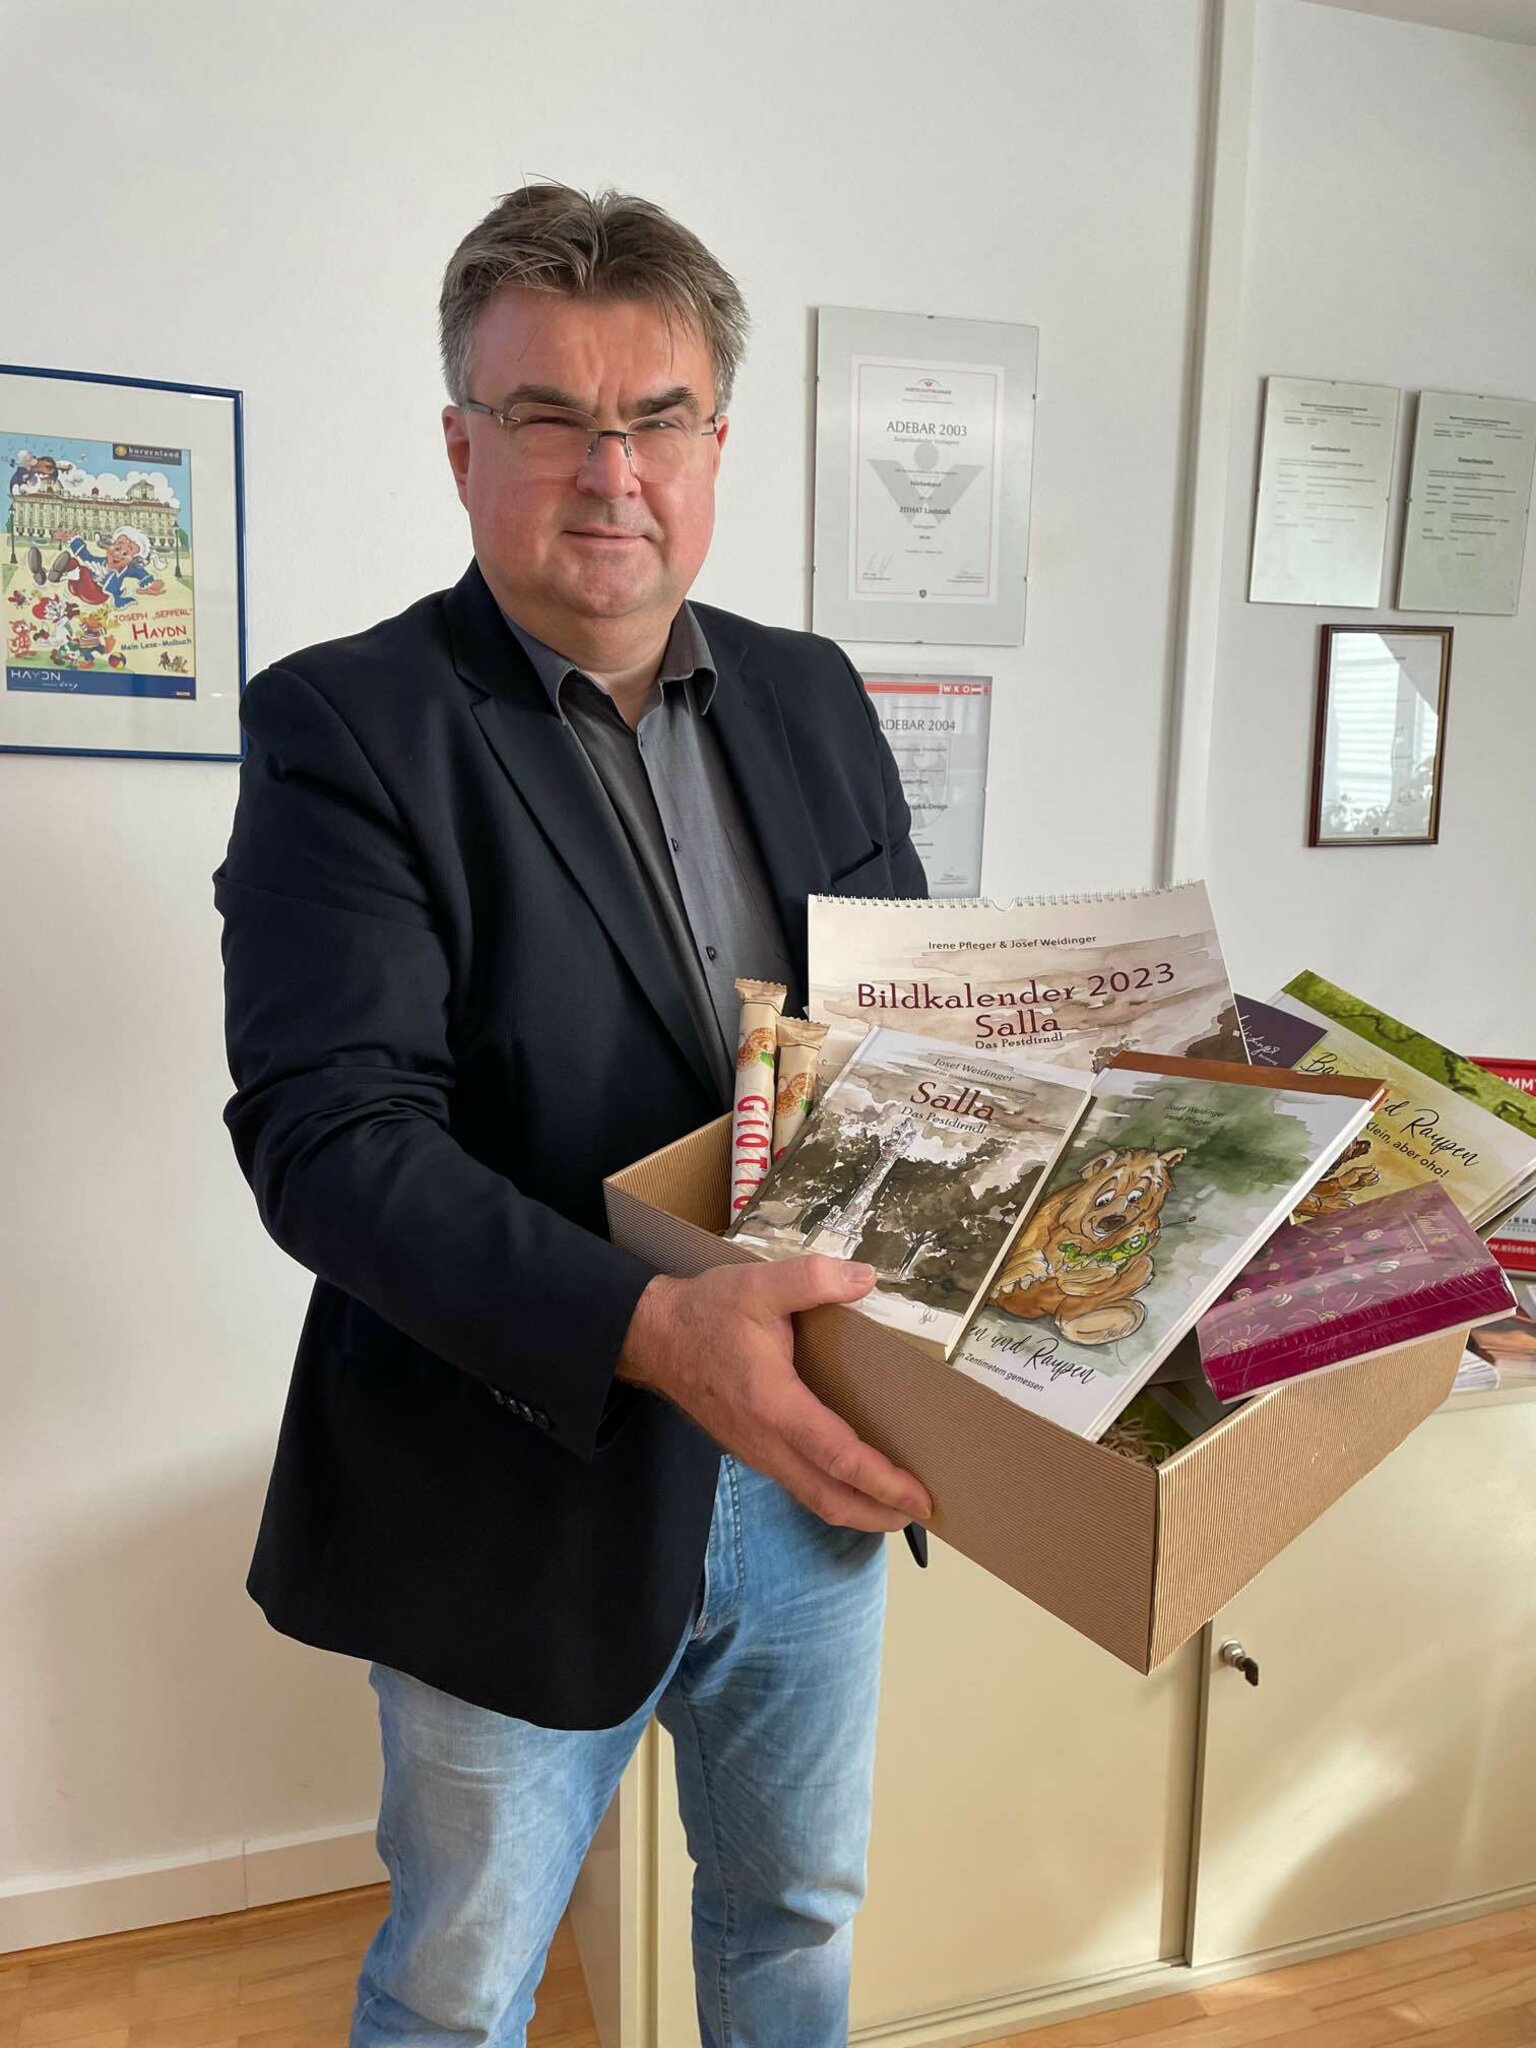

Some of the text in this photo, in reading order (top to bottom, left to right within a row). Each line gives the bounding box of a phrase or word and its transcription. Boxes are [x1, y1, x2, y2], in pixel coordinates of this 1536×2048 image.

[886, 420, 967, 436] ADEBAR 2003
[114, 612, 148, 622] JOSEPH
[11, 669, 61, 681] HAYDN
[928, 720, 955, 731] 2004
[928, 934, 1097, 951] Irene Pfleger & Josef Weidinger
[857, 962, 1175, 1010] Bildkalender 2023
[975, 1009, 1062, 1039] Salla
[975, 1032, 1063, 1050] Das Pestdirndl
[932, 1058, 961, 1071] Josef
[962, 1063, 1015, 1082] Weidinger
[910, 1081, 995, 1121] Salla
[901, 1106, 987, 1134] Das Pestdirndl
[1393, 1141, 1421, 1160] aber
[1420, 1157, 1450, 1178] oho!
[1488, 1243, 1536, 1254] w.eisens
[990, 1335, 1033, 1354] und
[964, 1352, 1008, 1377] Zentimetern
[1005, 1371, 1044, 1393] gemessen
